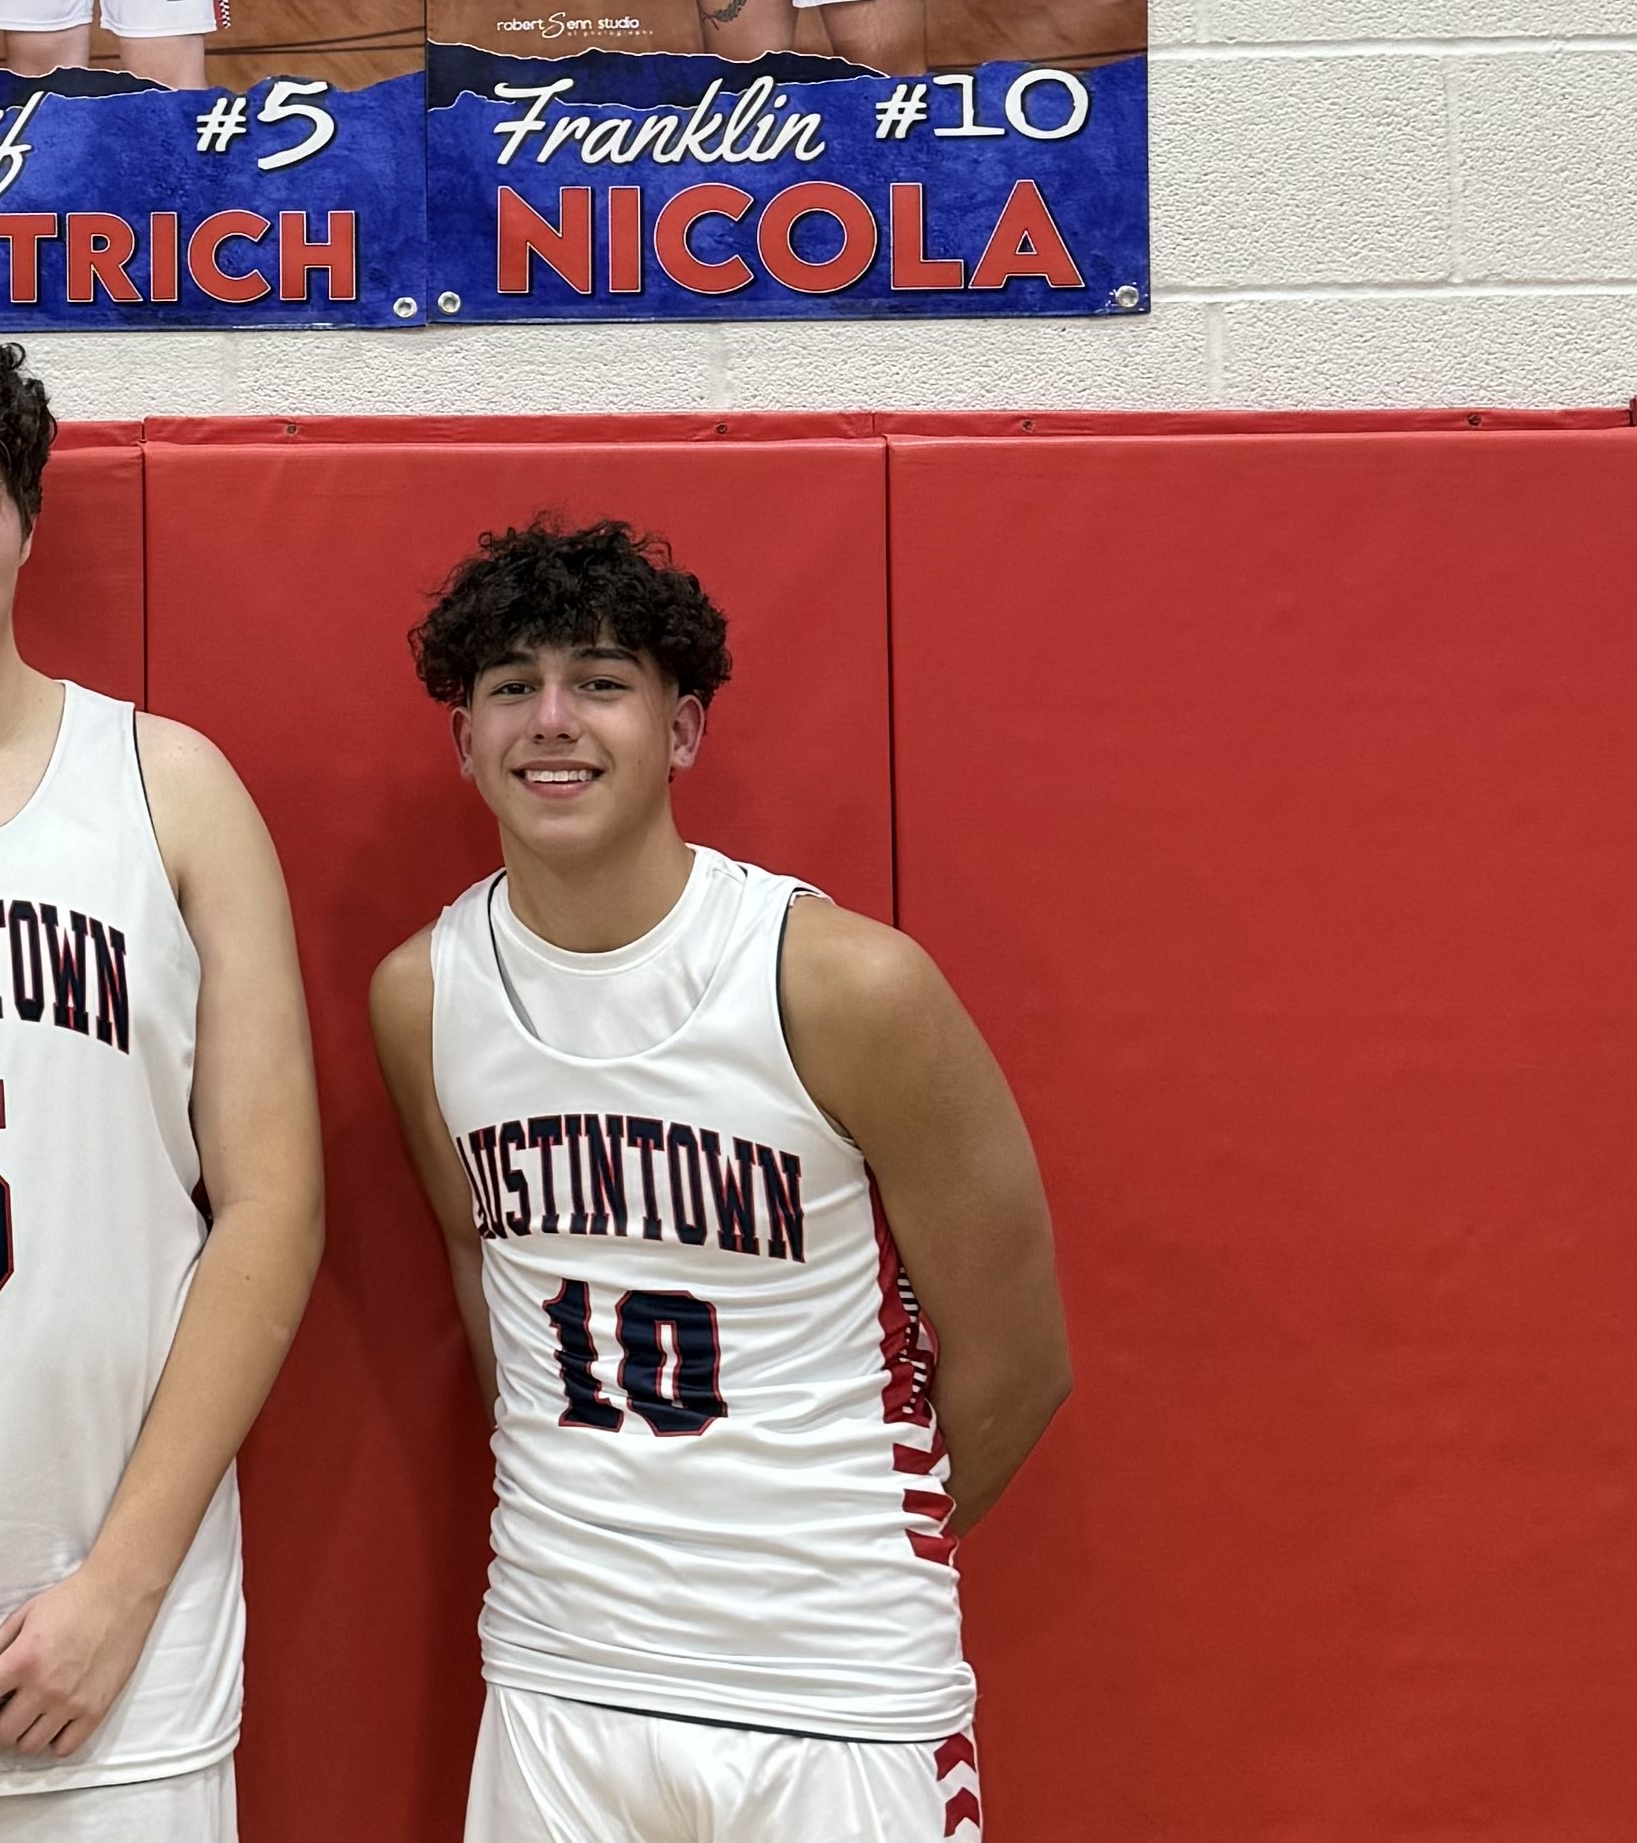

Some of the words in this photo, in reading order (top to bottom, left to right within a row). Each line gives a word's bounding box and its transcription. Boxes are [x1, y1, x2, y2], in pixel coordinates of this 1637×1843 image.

[496, 18, 545, 31] robert
[597, 16, 640, 29] studio
[195, 81, 338, 170] #5
[493, 76, 826, 166] Franklin
[875, 68, 1089, 140] #10
[496, 178, 1085, 294] NICOLA
[542, 1277, 730, 1437] 10
